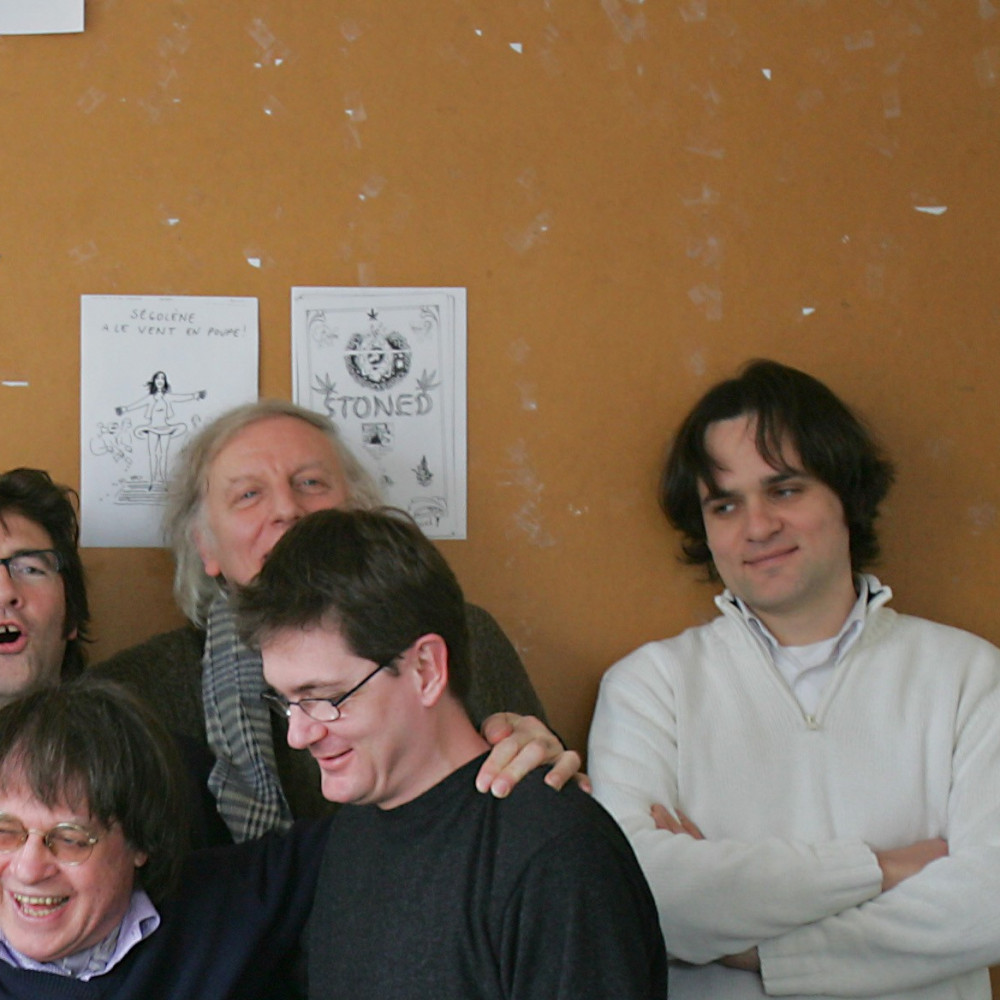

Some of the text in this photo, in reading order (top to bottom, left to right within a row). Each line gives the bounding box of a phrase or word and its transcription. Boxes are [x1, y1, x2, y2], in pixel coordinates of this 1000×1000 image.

[137, 325, 177, 335] VENT
[185, 327, 200, 336] EN
[323, 392, 434, 419] STONED
